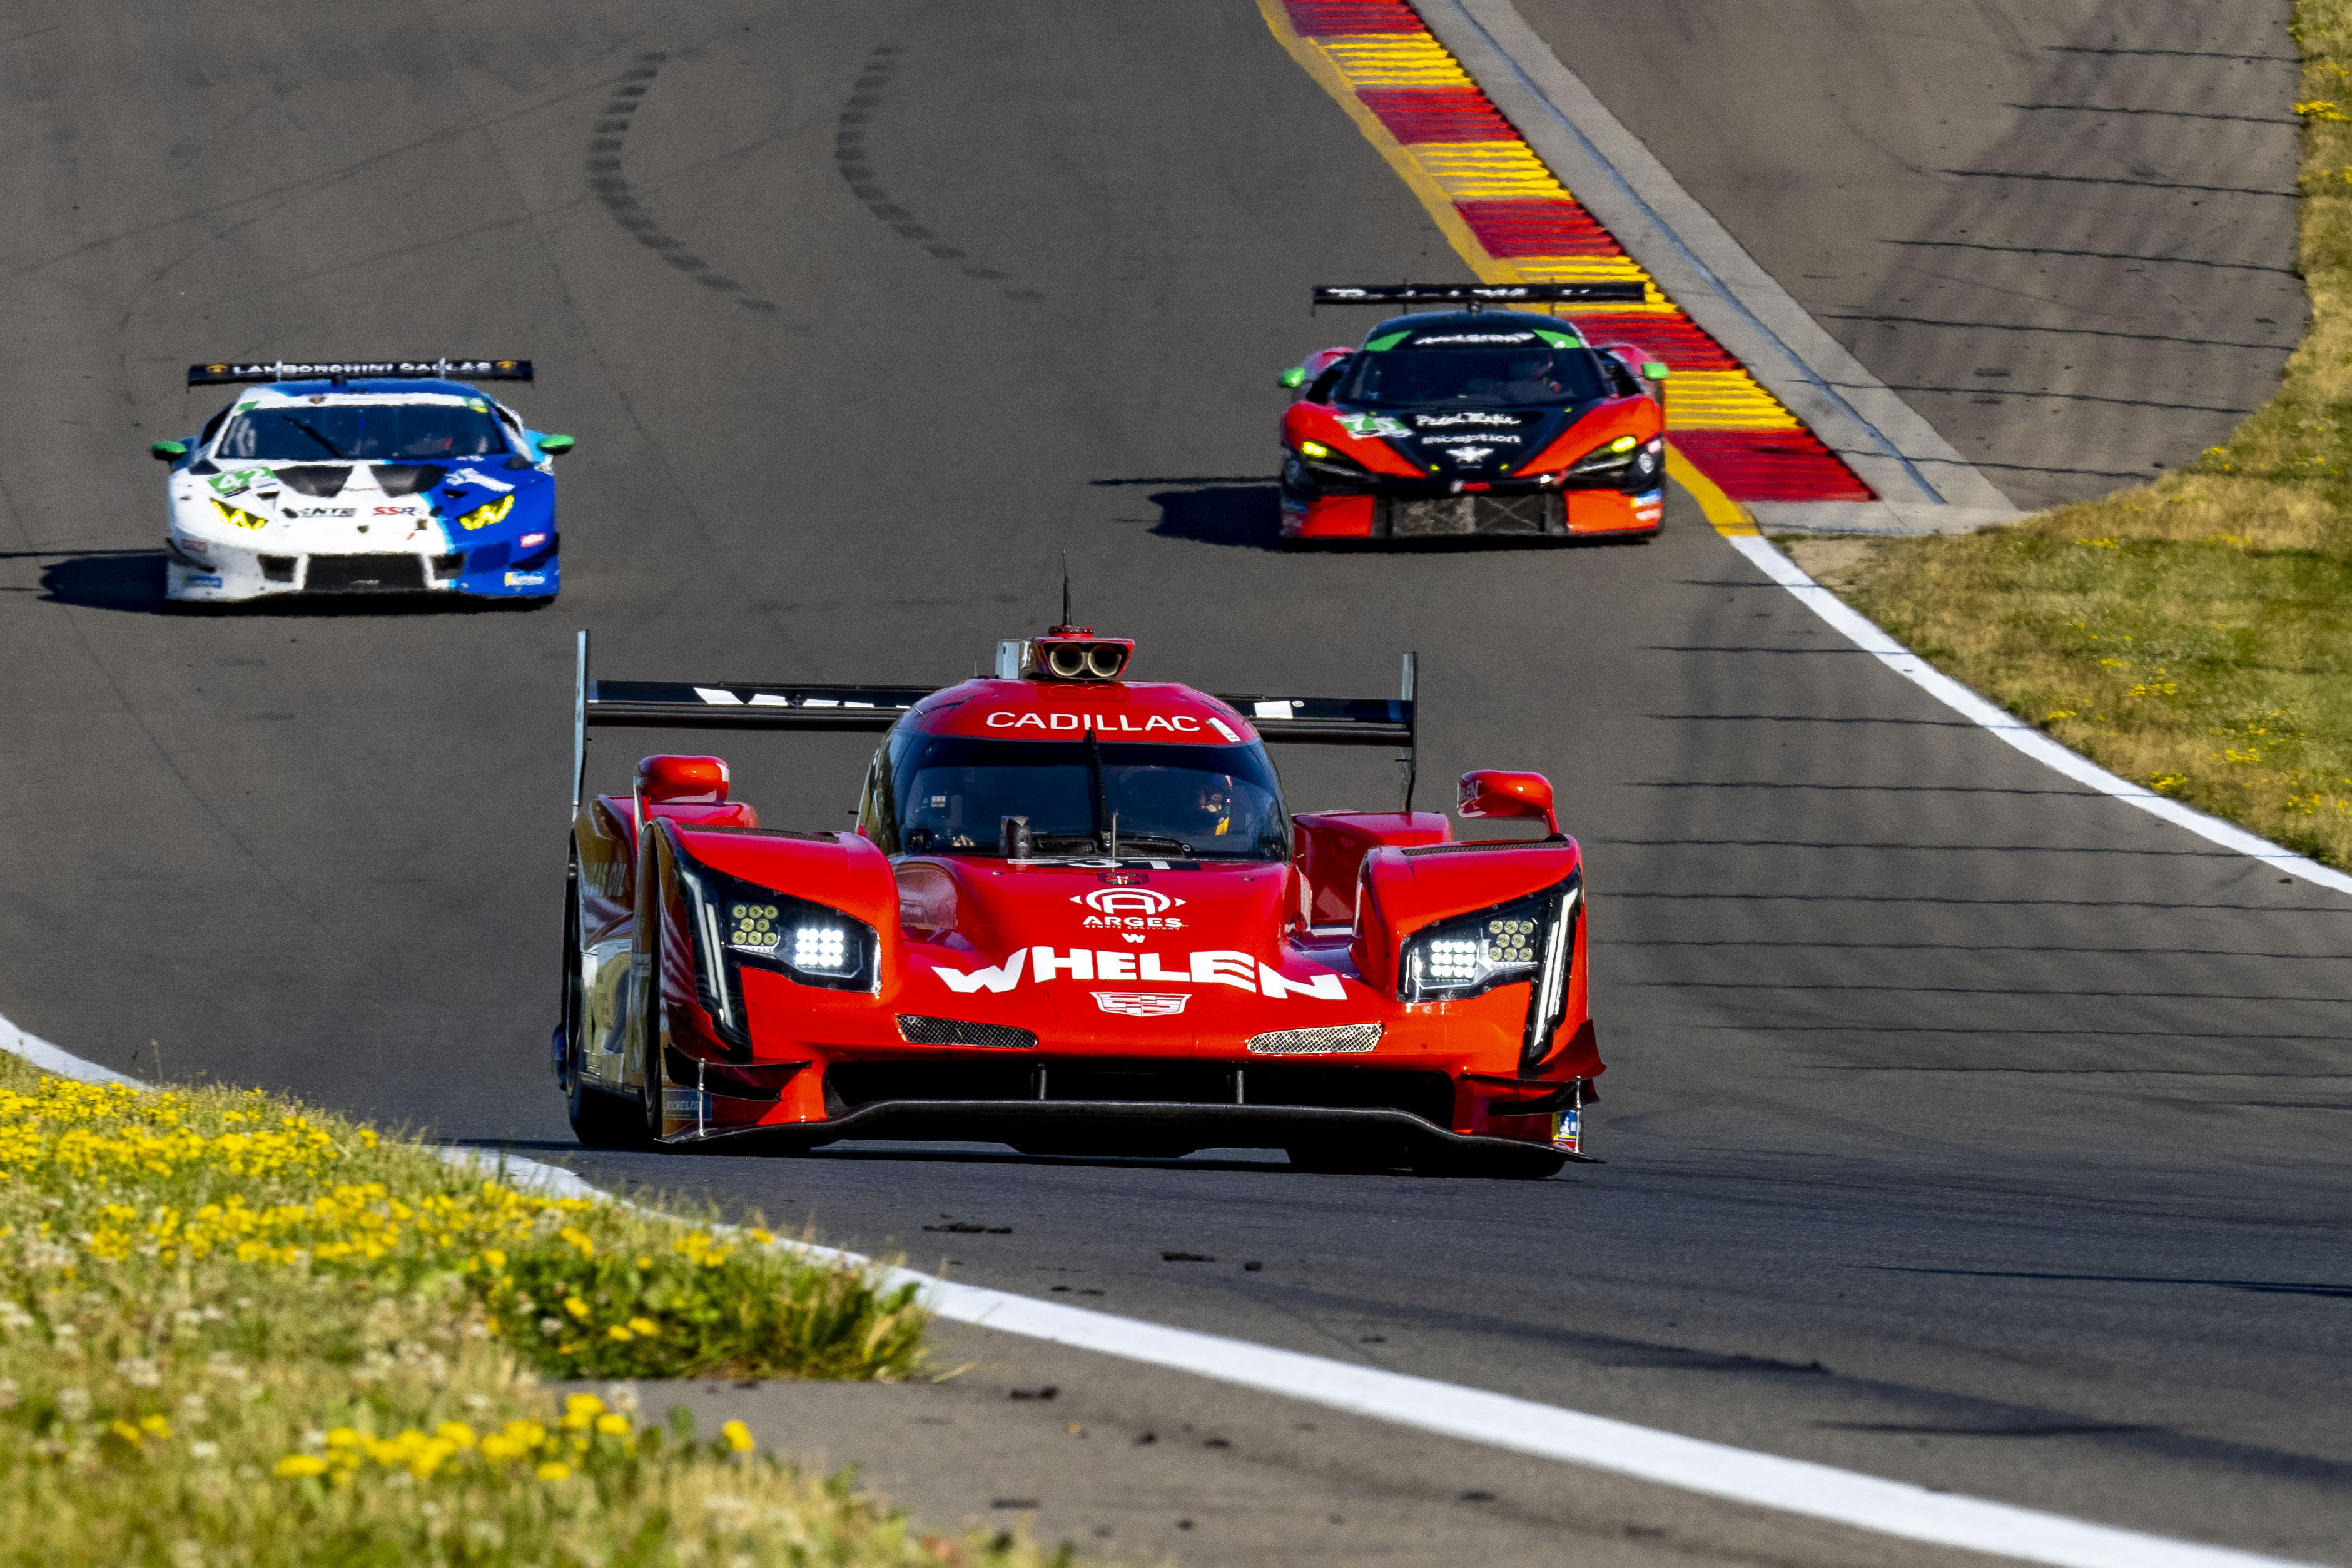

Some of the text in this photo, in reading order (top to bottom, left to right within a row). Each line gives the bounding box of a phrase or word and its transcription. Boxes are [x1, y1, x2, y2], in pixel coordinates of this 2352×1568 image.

[217, 468, 272, 489] 42
[372, 507, 415, 517] SSR
[986, 712, 1200, 731] CADILLAC
[1082, 916, 1182, 927] ARGES
[931, 946, 1348, 1000] WHELEN
